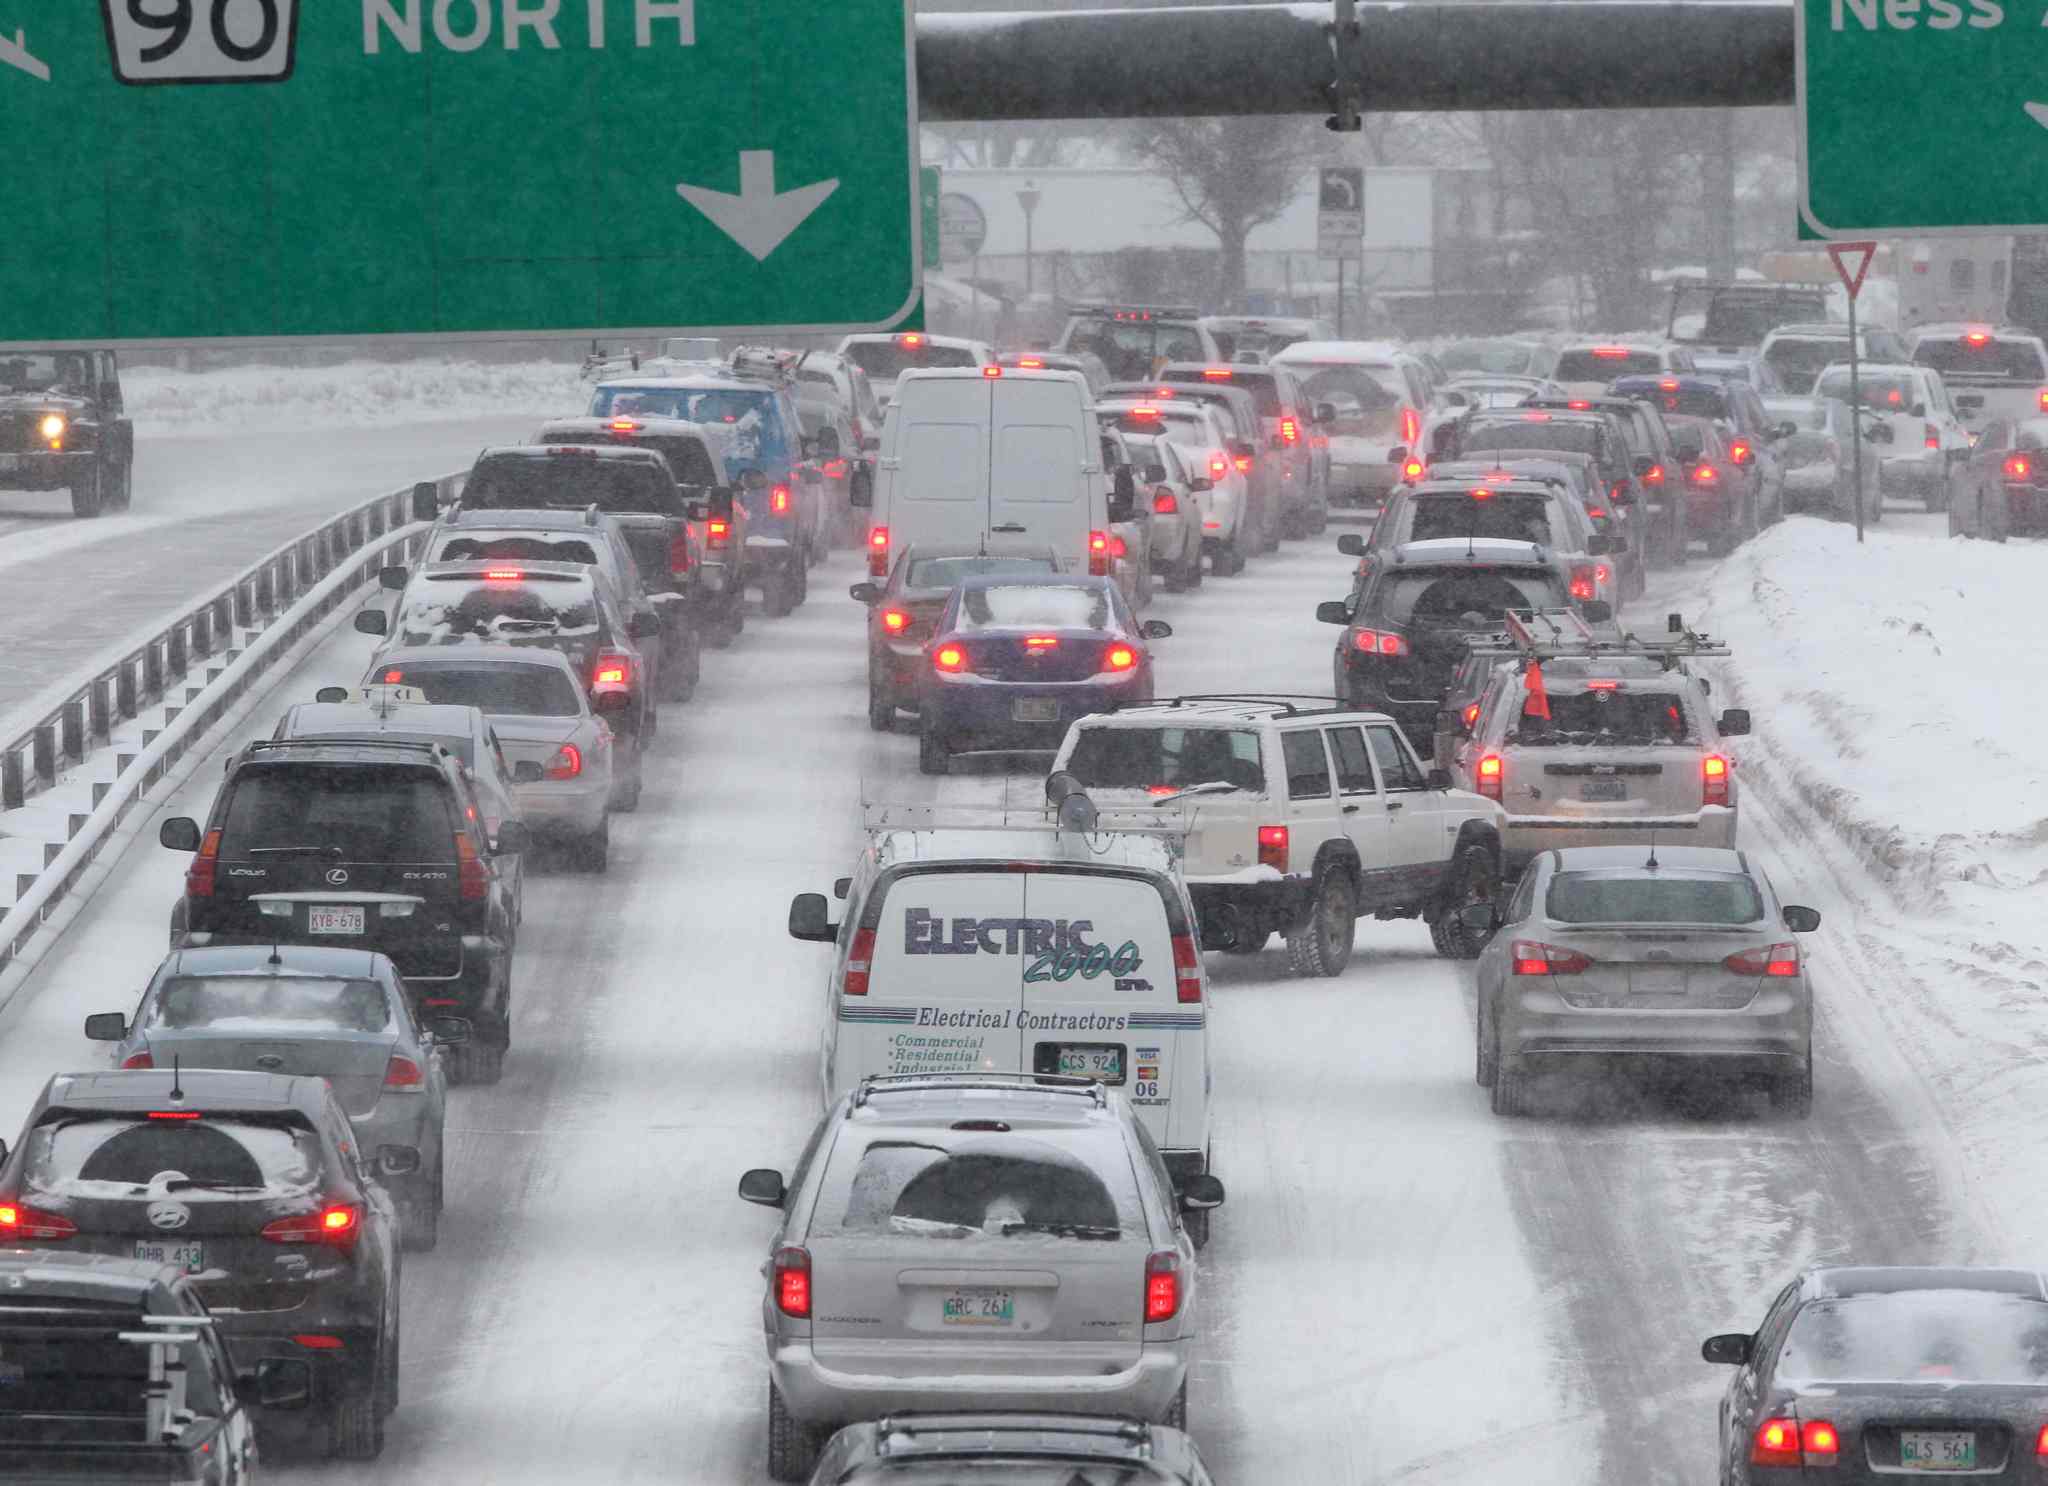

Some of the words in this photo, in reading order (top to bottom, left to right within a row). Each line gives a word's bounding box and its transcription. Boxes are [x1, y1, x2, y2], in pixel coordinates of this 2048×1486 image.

[1831, 0, 2004, 31] Ness
[127, 0, 279, 63] 90
[363, 0, 696, 54] NORTH
[311, 914, 361, 928] KYB-678
[1023, 939, 1141, 984] 2000
[917, 1007, 1010, 1028] Electrical
[1016, 1010, 1125, 1031] Contractors
[1061, 1055, 1086, 1069] CCS
[1093, 1055, 1117, 1070] 924
[1135, 1082, 1158, 1097] 06
[946, 1298, 974, 1315] GRC
[1905, 1441, 1934, 1459] GLS
[1943, 1442, 1970, 1459] 561
